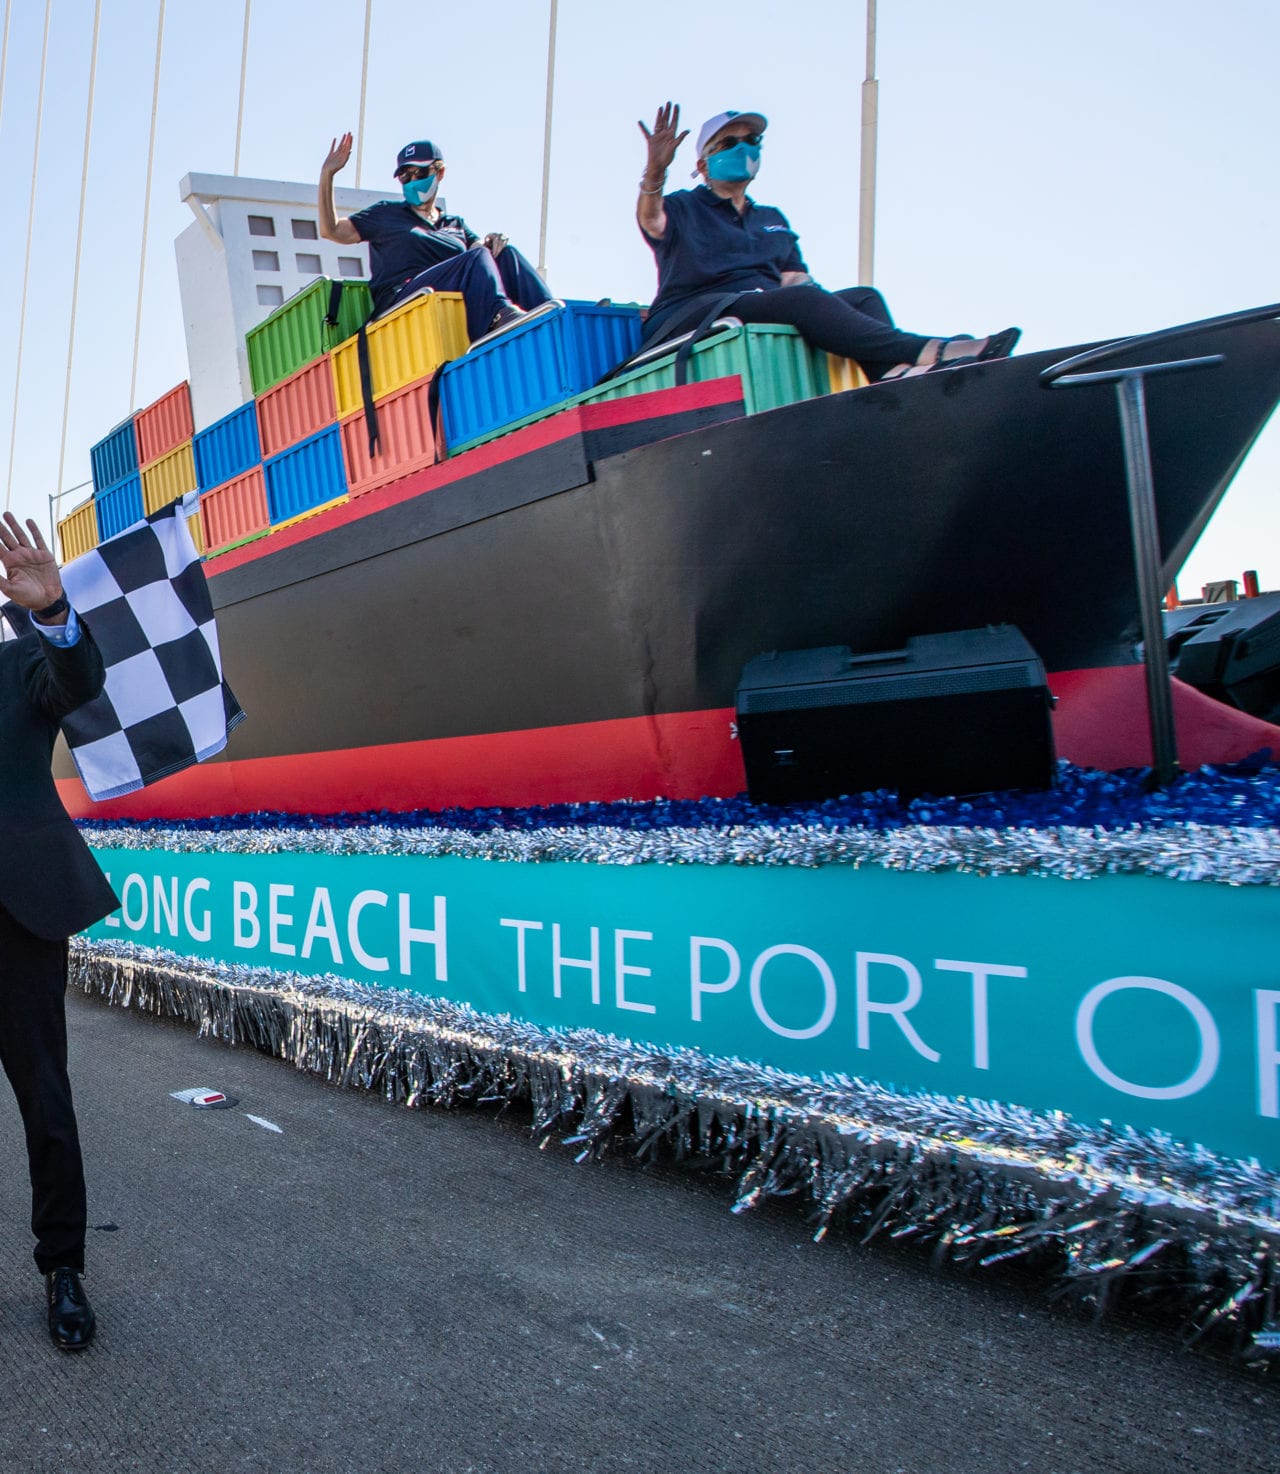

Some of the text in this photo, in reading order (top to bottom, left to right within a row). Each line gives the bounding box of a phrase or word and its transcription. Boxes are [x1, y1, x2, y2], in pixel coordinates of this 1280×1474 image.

[233, 881, 448, 982] BEACH
[500, 918, 657, 1015] THE
[689, 936, 1028, 1070] PORT
